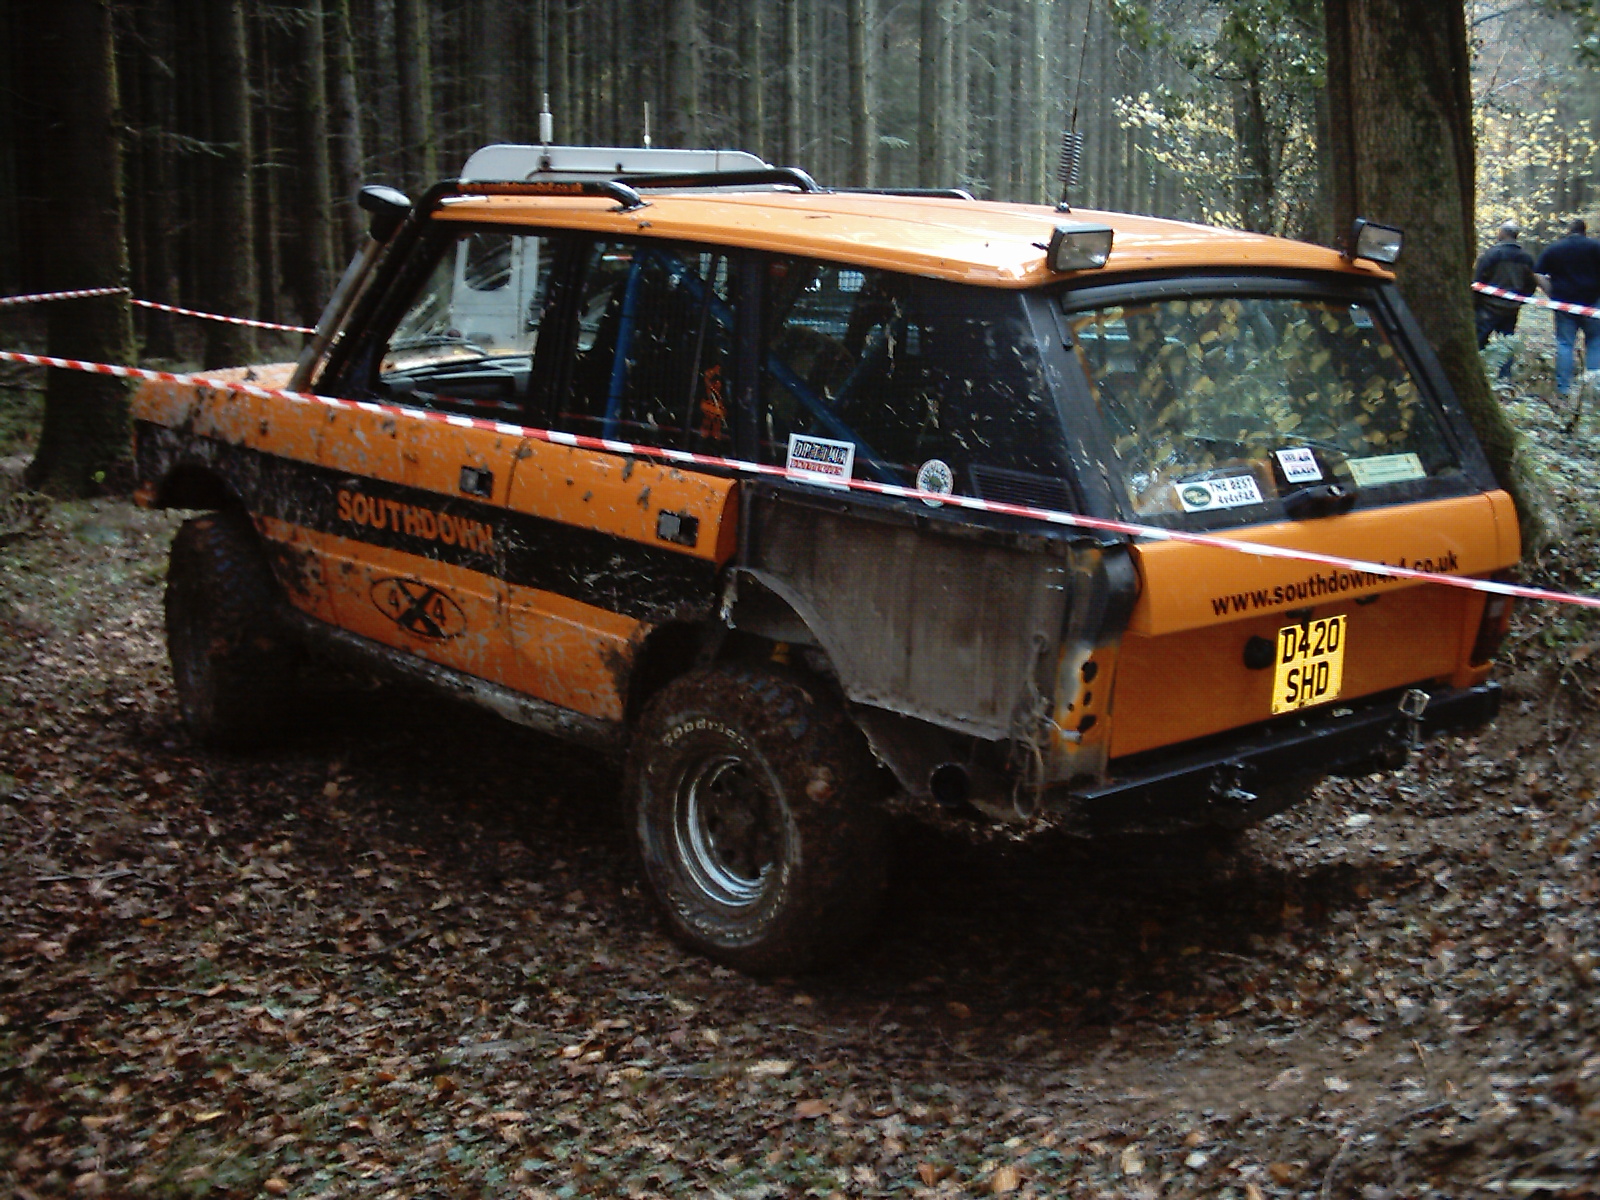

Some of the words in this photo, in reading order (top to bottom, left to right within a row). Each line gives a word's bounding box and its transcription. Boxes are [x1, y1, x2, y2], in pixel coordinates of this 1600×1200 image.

[337, 489, 495, 556] SOUTHDOWN
[1281, 617, 1341, 664] D420
[1285, 660, 1331, 703] SHD
